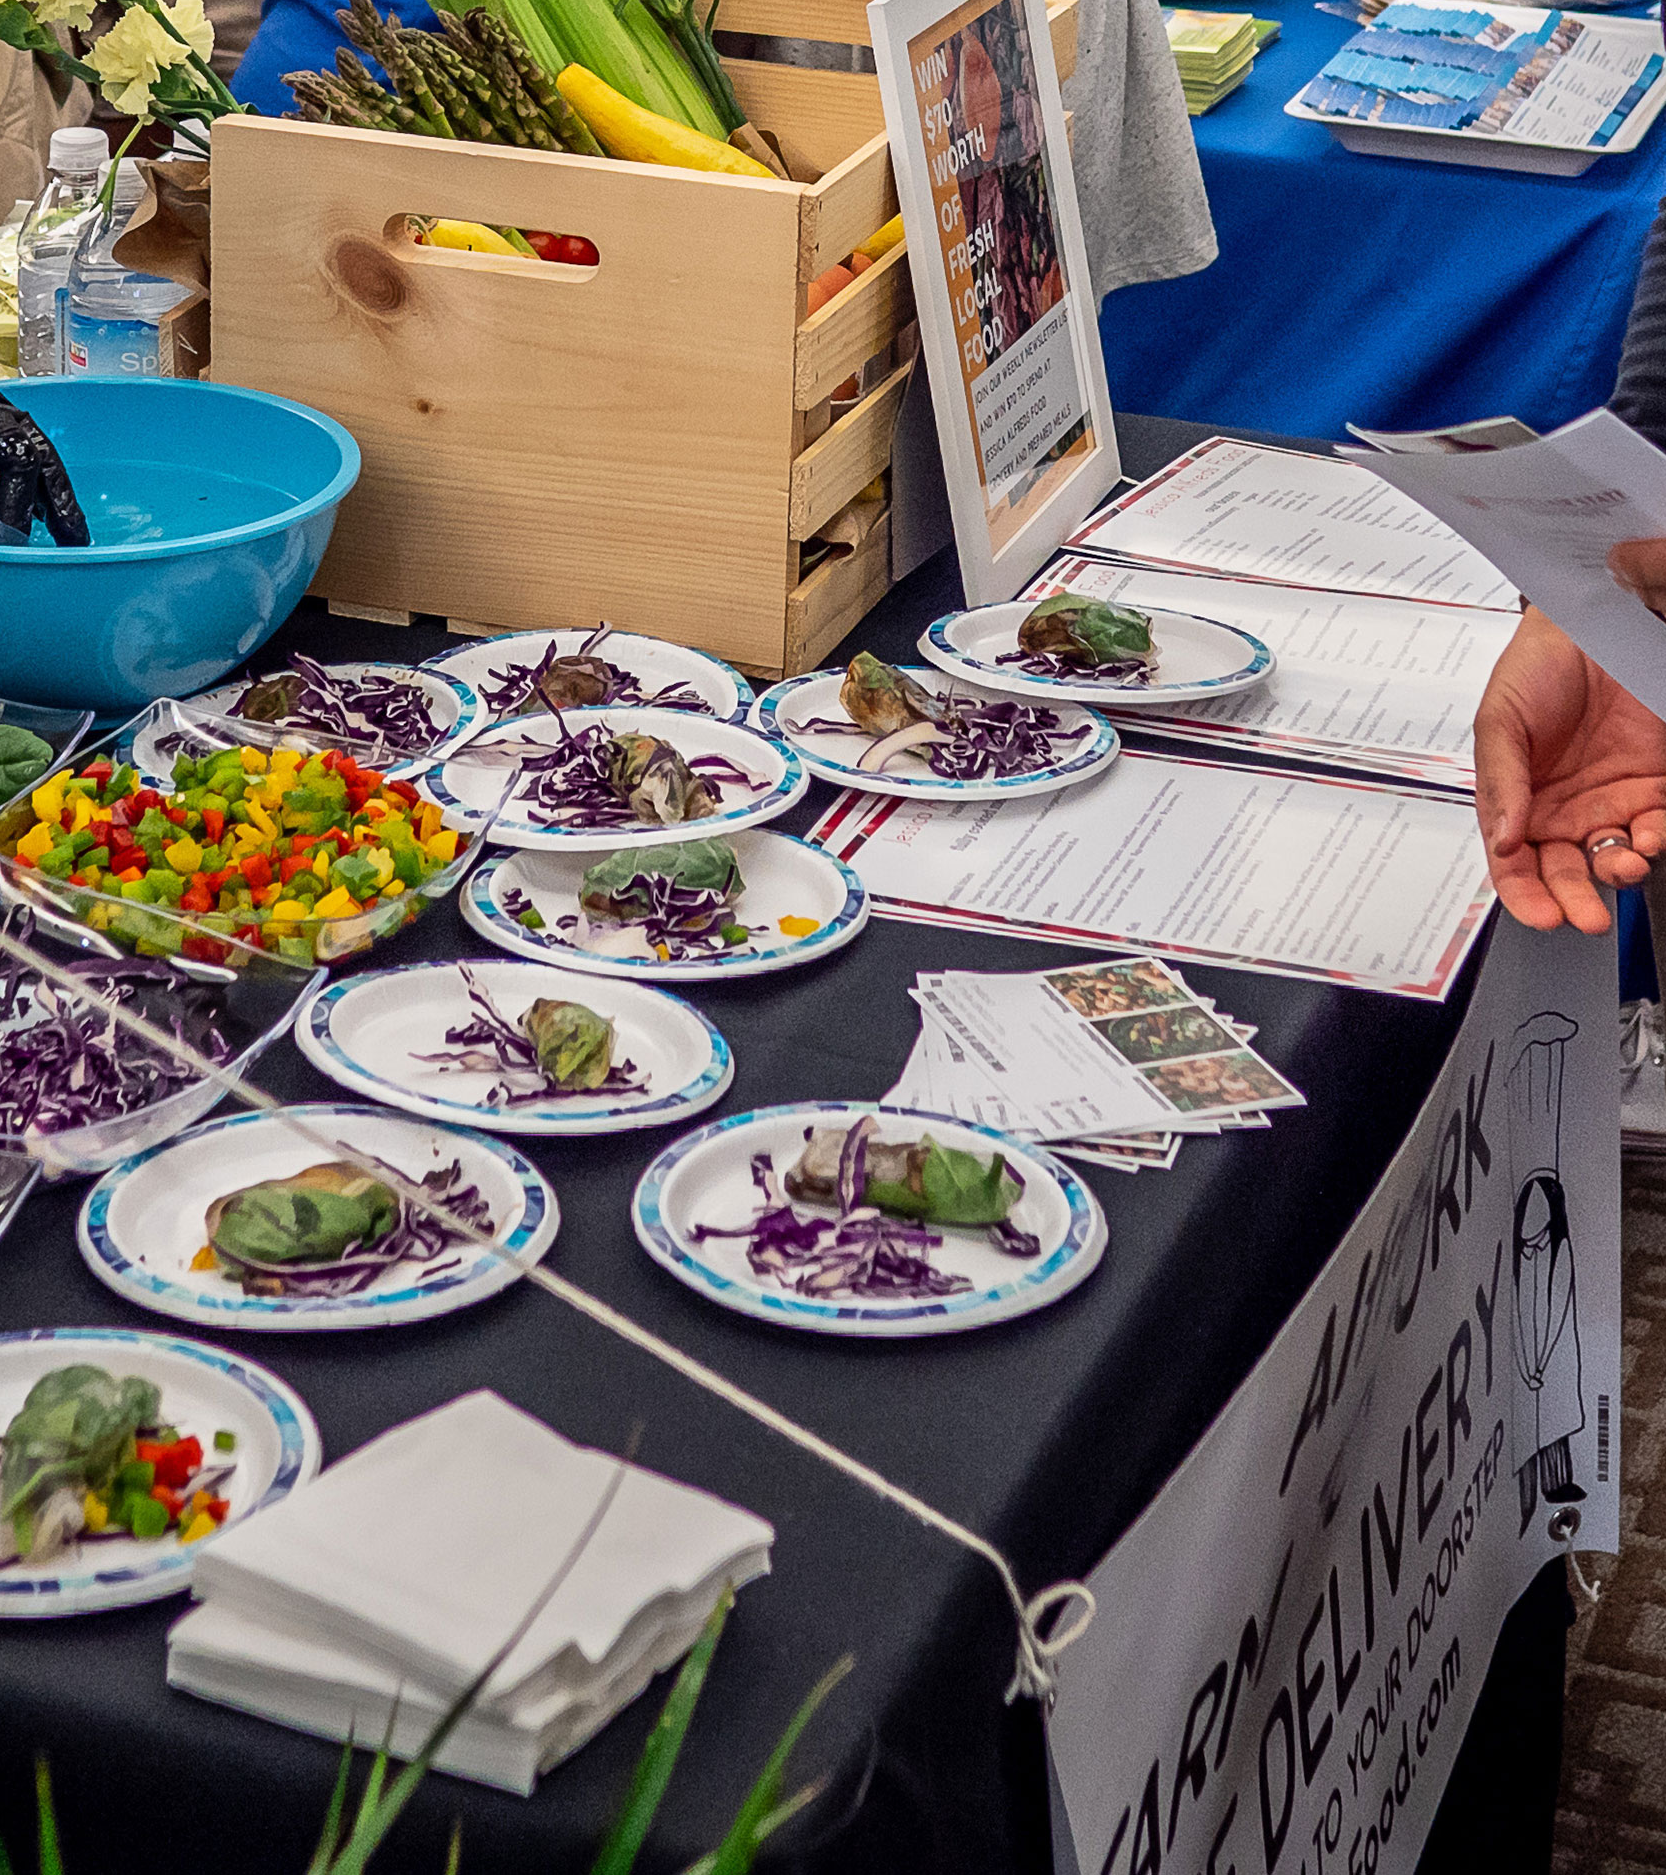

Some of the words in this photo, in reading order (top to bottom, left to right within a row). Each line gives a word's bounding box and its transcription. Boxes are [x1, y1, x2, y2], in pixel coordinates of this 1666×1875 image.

[915, 47, 949, 94] WIN
[925, 97, 952, 146] $70
[932, 122, 987, 187] WORTH
[940, 194, 963, 233] OF
[948, 218, 995, 281] FRESH
[956, 267, 1003, 327] LOCAL
[964, 315, 1004, 373] FOOD
[975, 385, 989, 409] JOIN
[989, 373, 1001, 392] OUR
[1002, 351, 1025, 380] WEEKLY
[1025, 318, 1059, 359] NEWSLETTER
[993, 401, 1007, 422] WIN
[1026, 366, 1044, 392] SPEND
[1030, 395, 1047, 419] FOOD
[1259, 1238, 1503, 1875] DELIVERY
[1312, 1787, 1343, 1875] TO
[1347, 1646, 1403, 1798] YOUR
[1407, 1419, 1506, 1673] DOORSTEP
